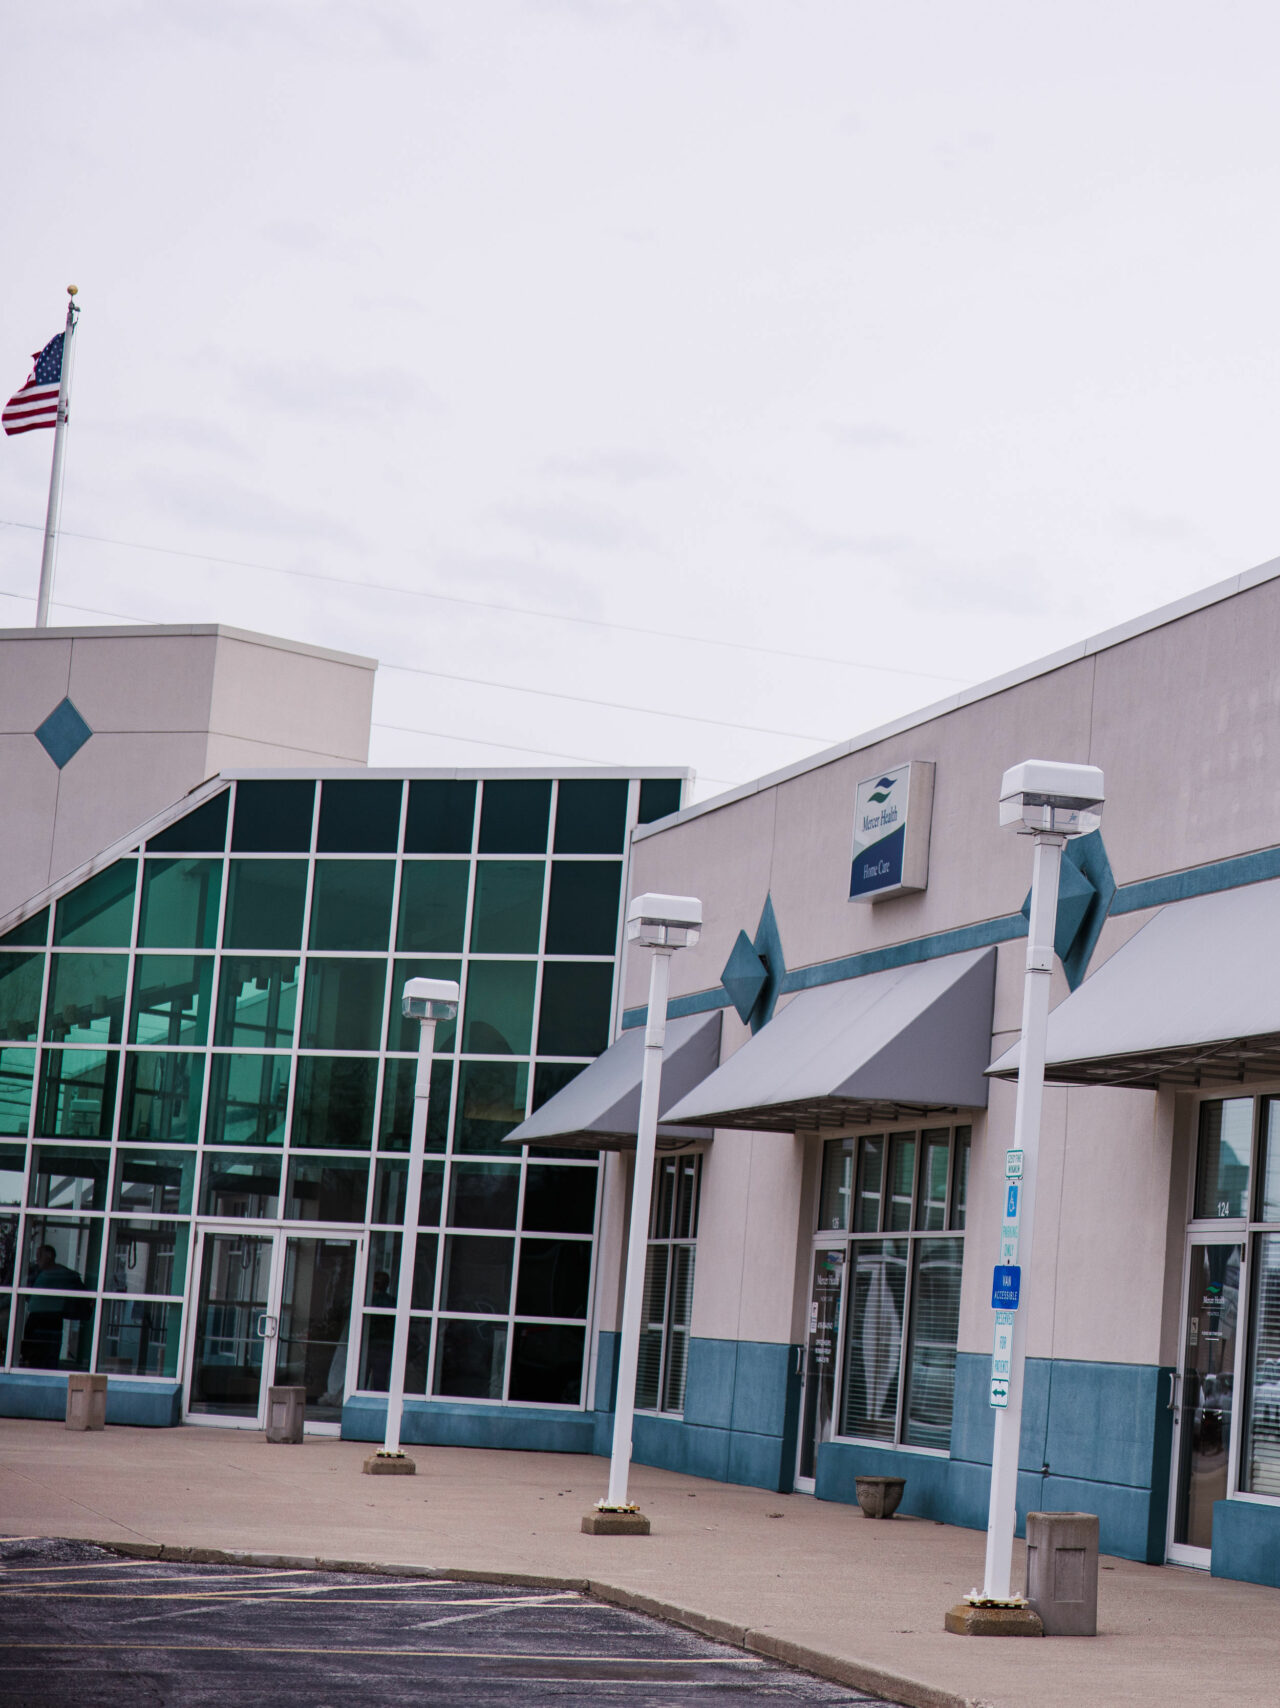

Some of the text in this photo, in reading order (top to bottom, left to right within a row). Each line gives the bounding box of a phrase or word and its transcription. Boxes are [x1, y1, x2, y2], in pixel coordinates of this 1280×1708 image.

[862, 805, 898, 832] Mercer Health
[863, 859, 890, 879] Home Care
[1217, 1201, 1230, 1217] 124
